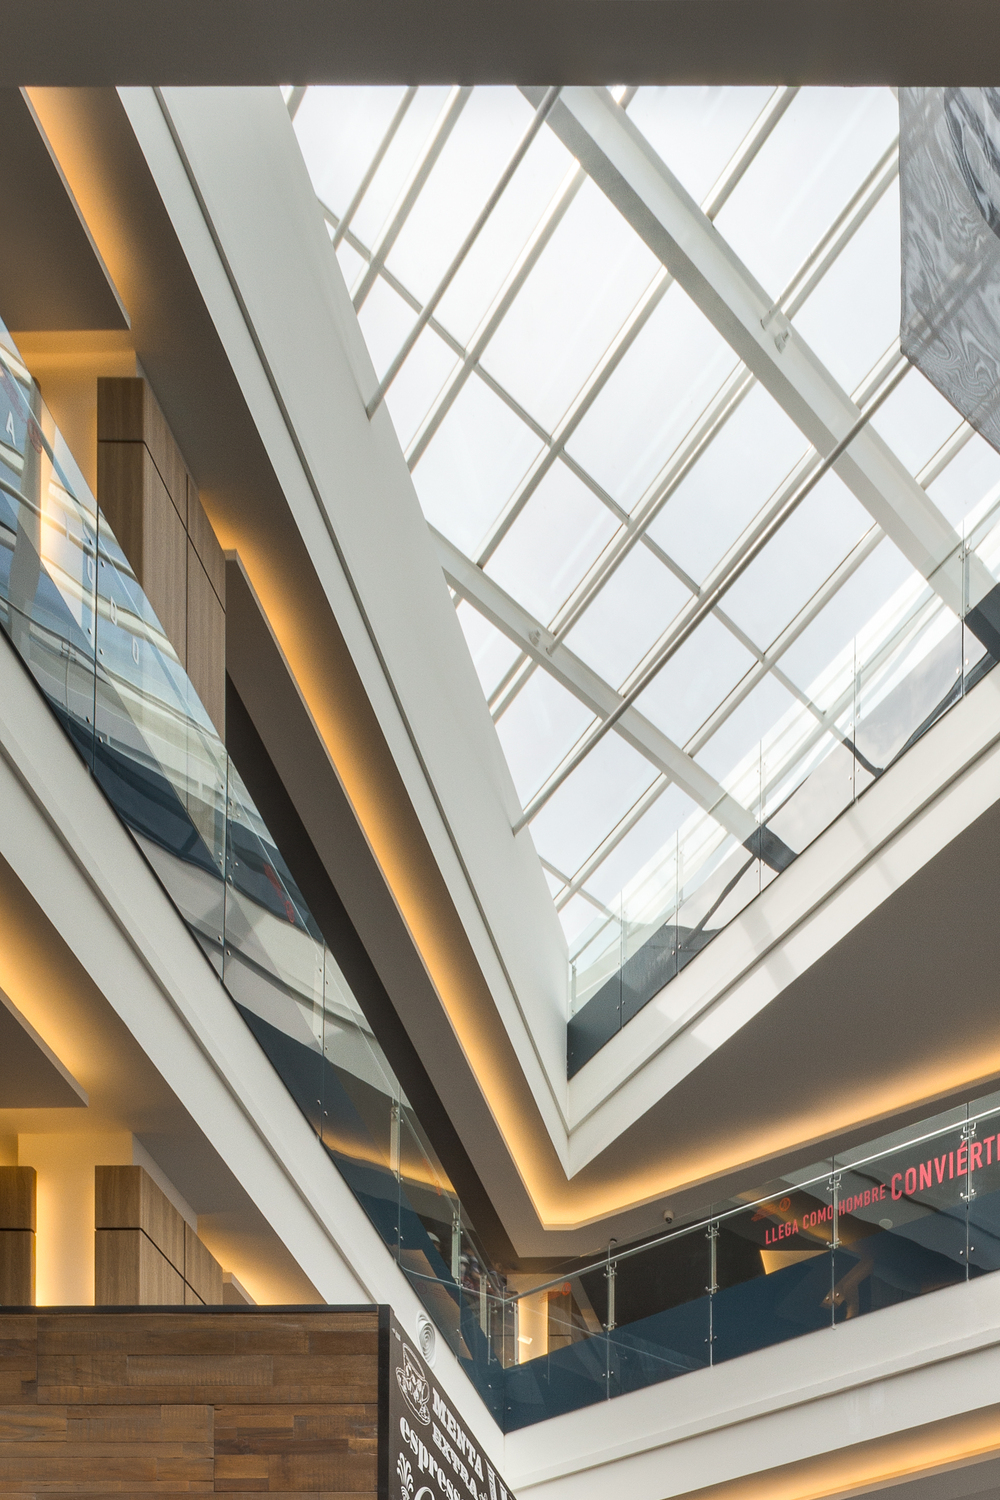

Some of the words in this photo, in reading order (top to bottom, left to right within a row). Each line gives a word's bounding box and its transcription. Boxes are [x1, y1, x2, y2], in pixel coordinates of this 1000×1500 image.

[765, 1219, 799, 1245] LLEGA
[802, 1204, 833, 1230] COMO
[838, 1183, 886, 1216] HOMBRE
[432, 1387, 484, 1482] MENTA
